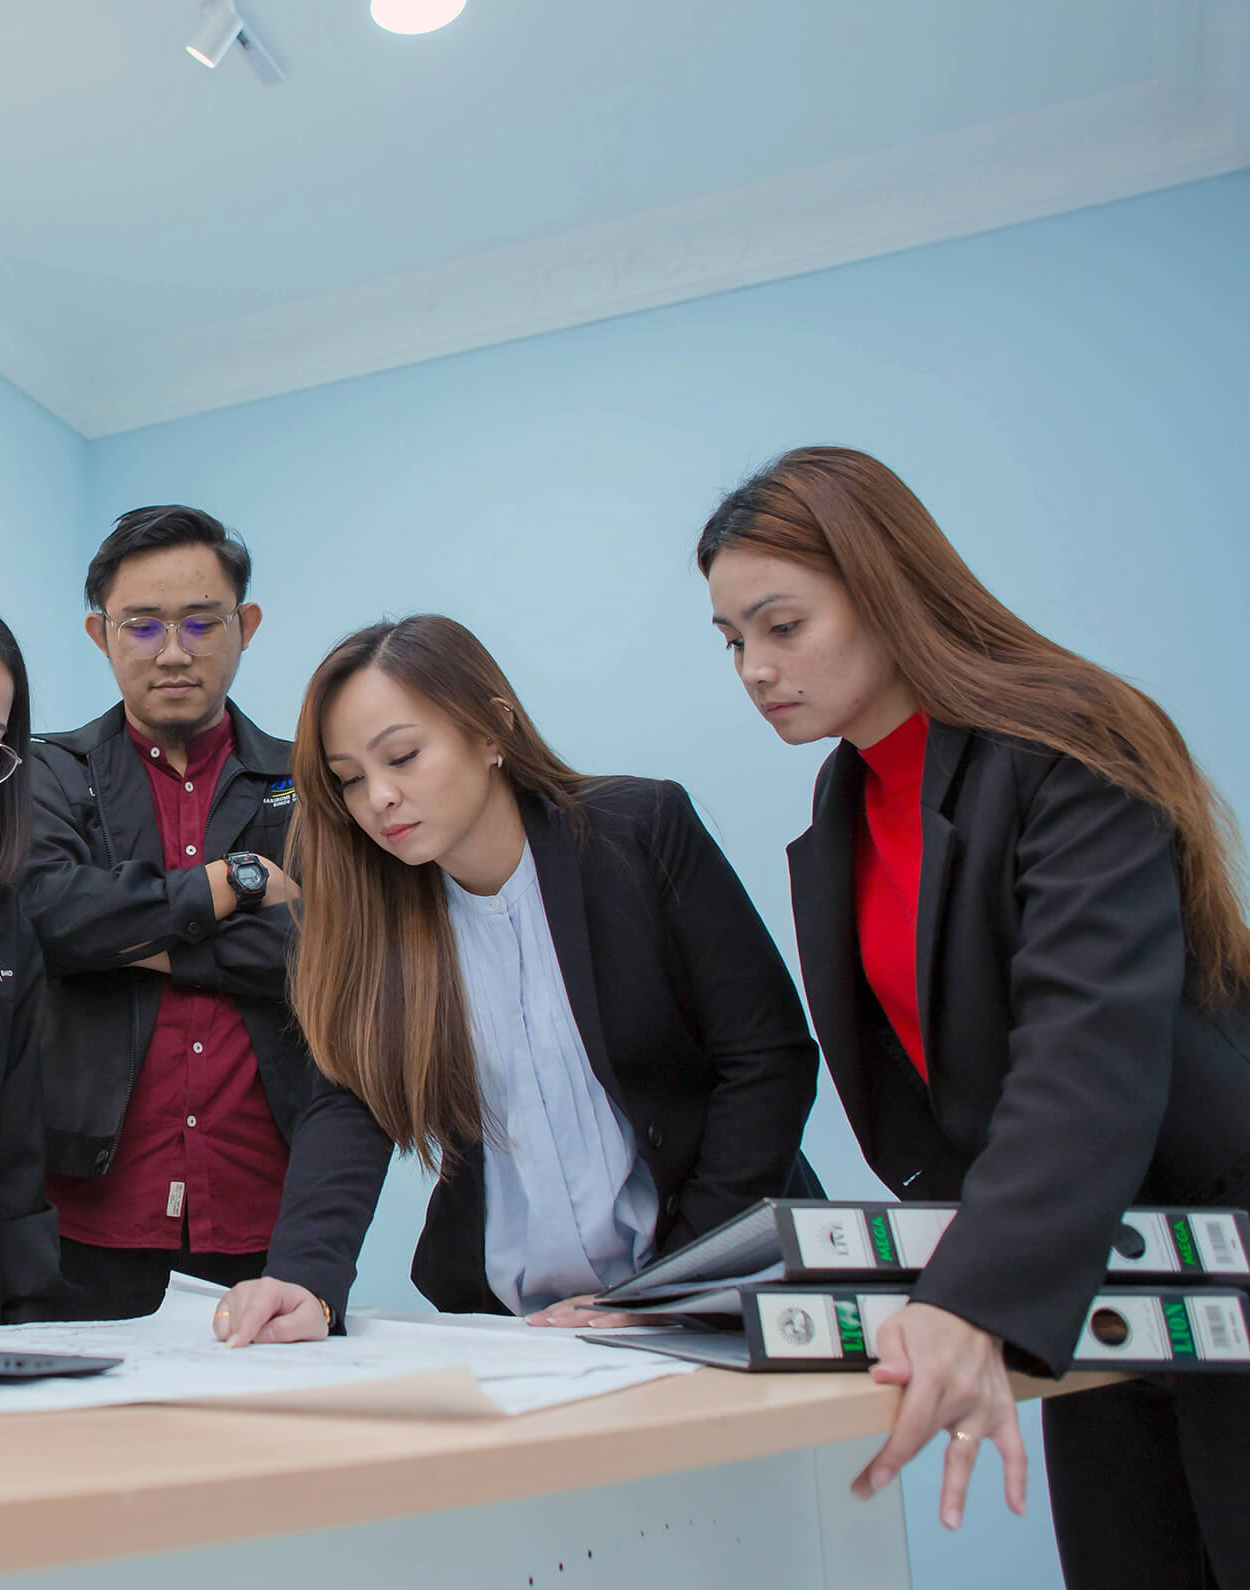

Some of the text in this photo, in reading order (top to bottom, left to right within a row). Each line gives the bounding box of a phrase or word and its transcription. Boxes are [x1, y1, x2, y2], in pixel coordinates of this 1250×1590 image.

[871, 1215, 894, 1262] MEGA
[1173, 1220, 1197, 1266] MEGA
[1163, 1303, 1193, 1353] LION
